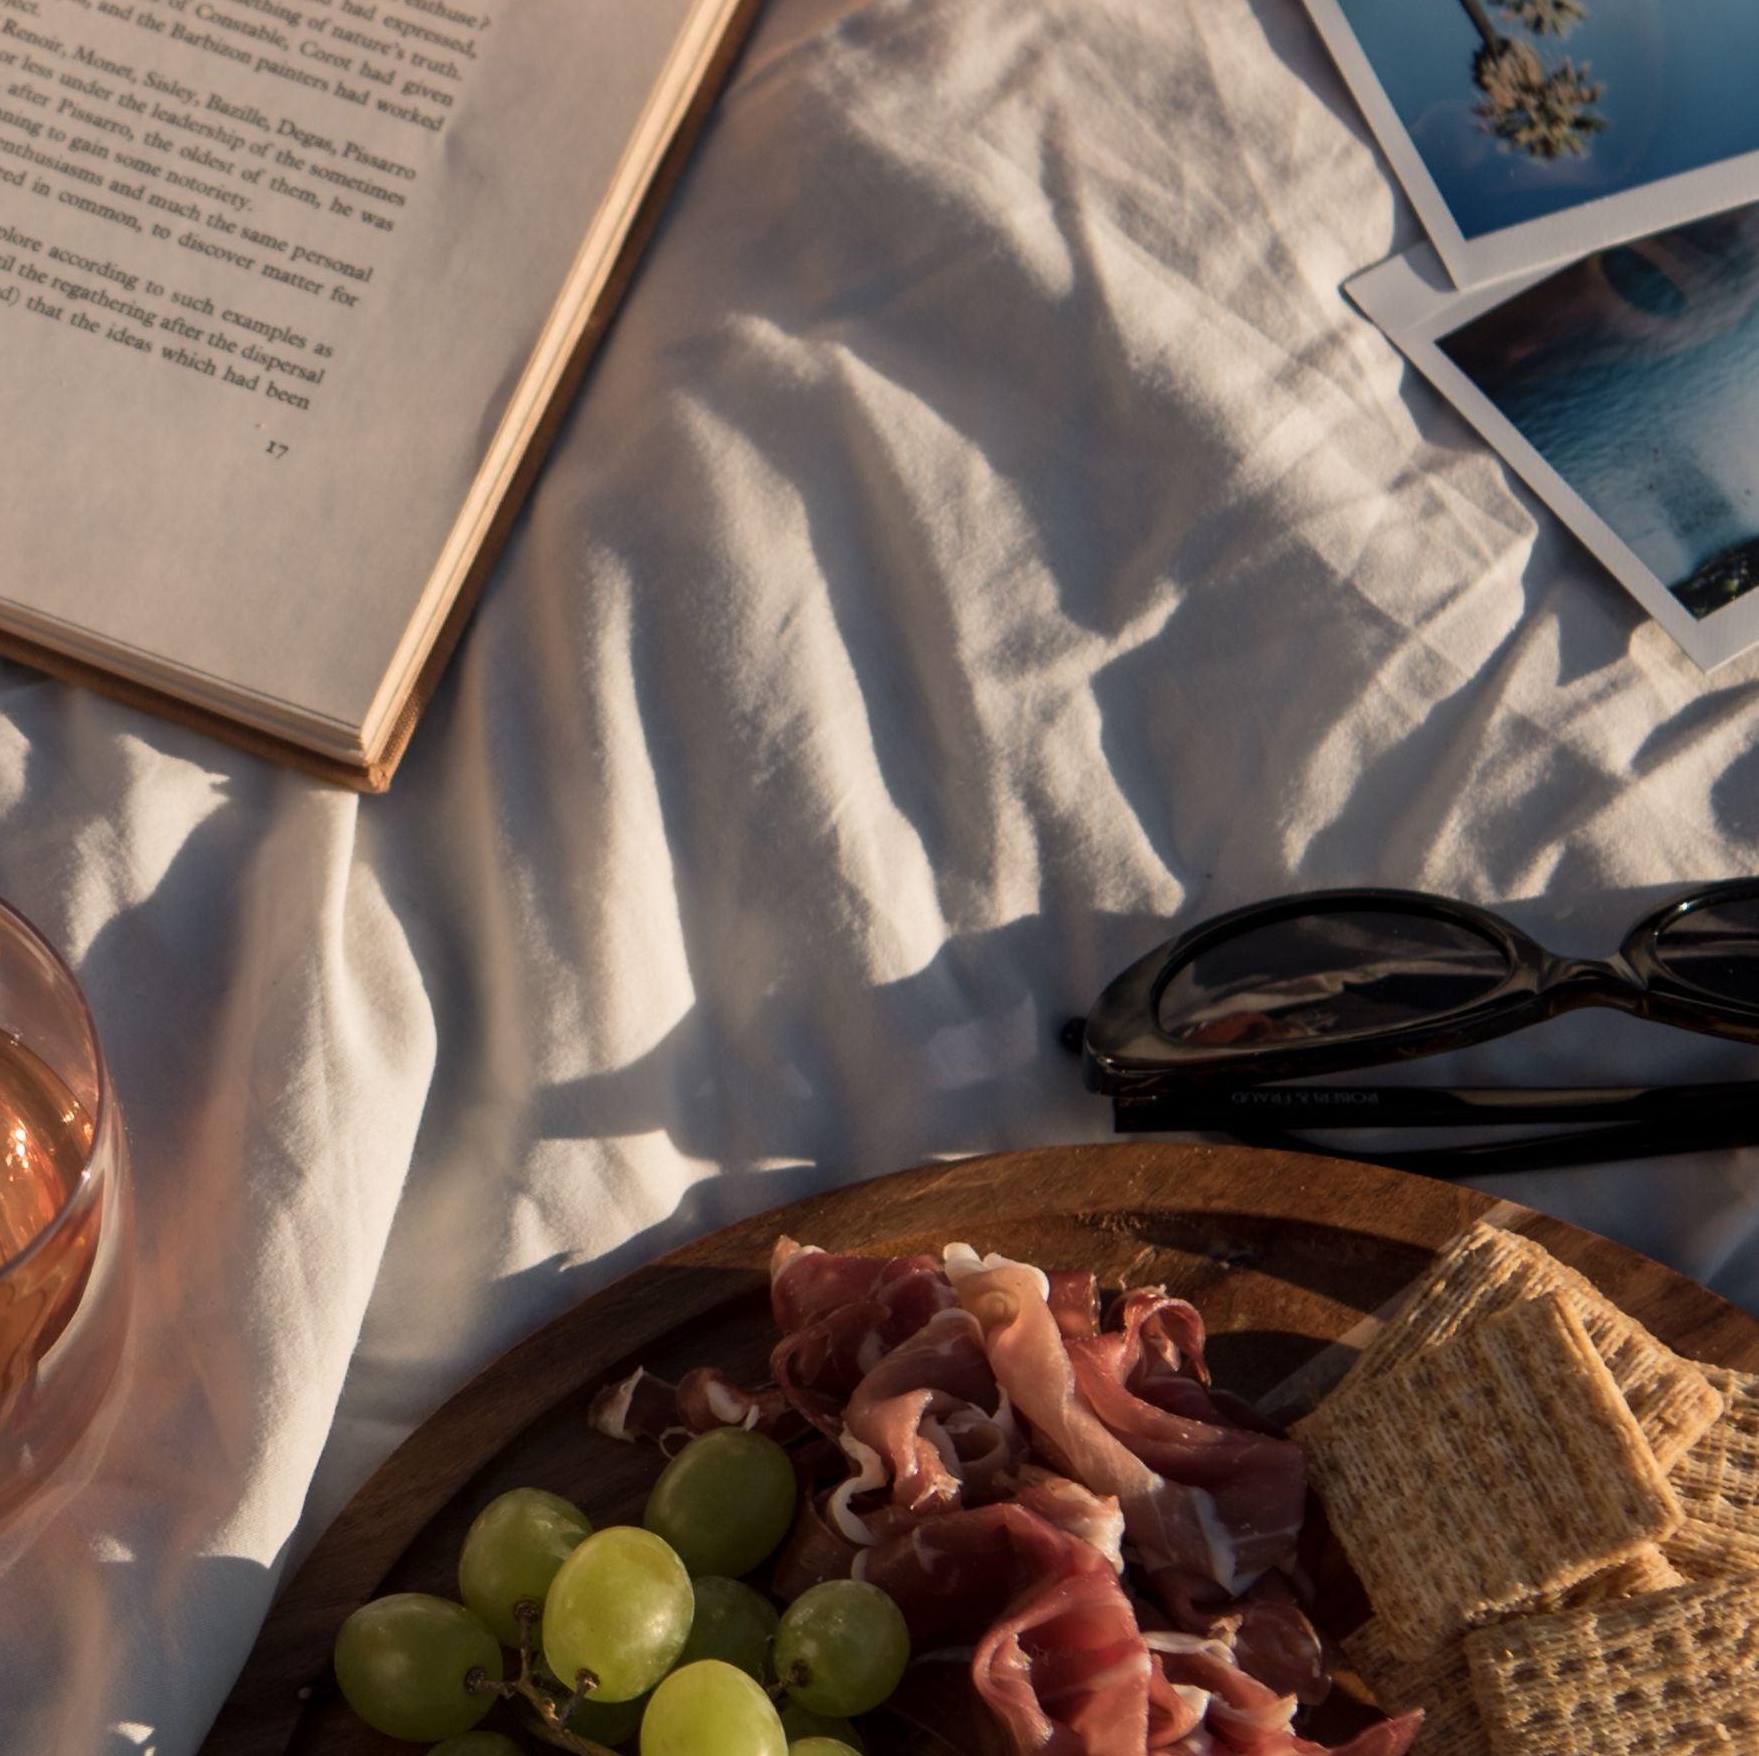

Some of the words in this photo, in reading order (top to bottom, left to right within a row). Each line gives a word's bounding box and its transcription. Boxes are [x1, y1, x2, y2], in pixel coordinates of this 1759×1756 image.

[0, 17, 66, 59] Renoir,
[71, 44, 137, 85] Monet,
[142, 70, 201, 108] Sisley,
[204, 92, 271, 133] Bazille,
[275, 117, 337, 157] Degas,
[341, 140, 417, 181] Pissarro
[193, 2, 290, 53] Constable,
[298, 40, 354, 72] Corot
[357, 59, 397, 87] had
[399, 79, 455, 109] given
[30, 175, 52, 199] in
[57, 190, 143, 234] common,
[150, 222, 173, 241] to
[177, 231, 256, 271] discover
[259, 263, 325, 296] matter
[329, 284, 360, 309] for
[107, 179, 147, 202] and
[146, 193, 202, 223] much
[205, 212, 238, 235] the
[239, 226, 289, 253] same
[289, 244, 375, 284] personal
[17, 262, 49, 285] the
[49, 276, 158, 328] regathering
[158, 316, 205, 342] after
[206, 332, 239, 354] the
[240, 343, 327, 386] dispersal
[25, 295, 65, 322] that
[69, 311, 101, 334] the
[104, 323, 154, 354] ideas
[161, 346, 217, 377] which
[221, 364, 261, 392] had
[265, 379, 311, 412] been
[47, 245, 140, 292] according
[144, 280, 166, 297] to
[169, 291, 216, 317] such
[220, 309, 308, 350] examples
[312, 342, 335, 359] as
[265, 439, 290, 460] 17
